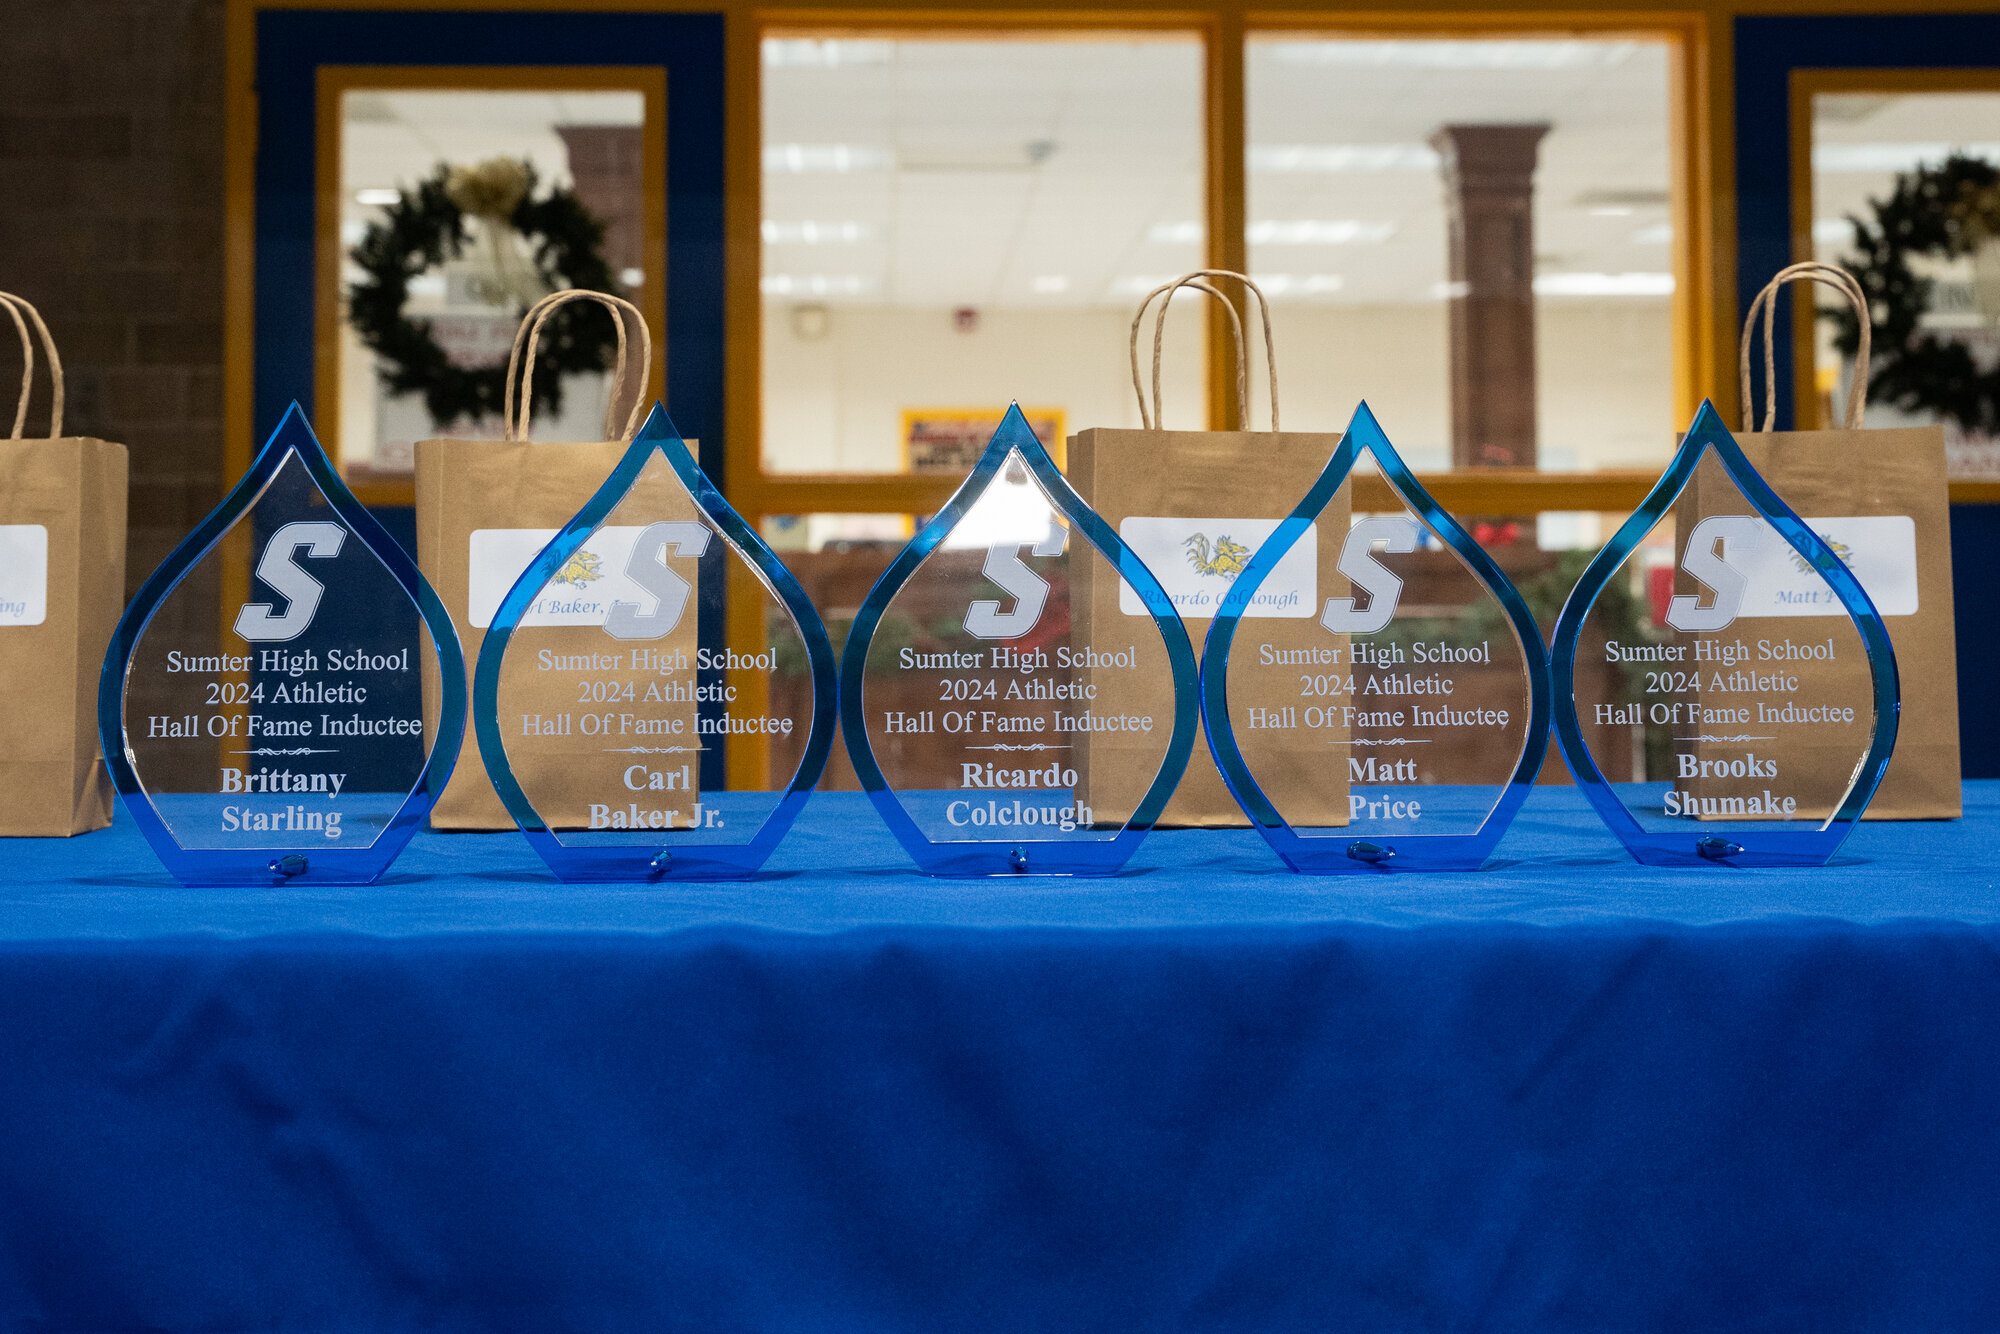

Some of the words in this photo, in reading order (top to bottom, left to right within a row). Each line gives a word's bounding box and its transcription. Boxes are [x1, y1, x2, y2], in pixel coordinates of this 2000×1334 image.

[233, 521, 347, 642] S
[602, 521, 713, 641] S
[1320, 517, 1420, 635] S
[1665, 515, 1764, 632] S
[548, 598, 604, 615] Baker,
[1774, 590, 1818, 604] Matt
[166, 650, 253, 673] Sumter
[259, 650, 319, 677] High
[327, 648, 408, 672] School
[538, 650, 622, 672] Sumter
[630, 648, 688, 676] High
[697, 648, 778, 671] School
[900, 648, 984, 670] Sumter
[990, 646, 1049, 674] High
[1057, 646, 1136, 669] School
[1259, 644, 1342, 666] Sumter
[1350, 642, 1406, 669] High
[1413, 640, 1490, 664] School
[1605, 640, 1687, 662] Sumter
[1693, 640, 1750, 667] High
[1757, 638, 1836, 661] School
[205, 682, 265, 705] 2024
[271, 681, 367, 705] Athletic
[578, 681, 636, 703] 2024
[643, 679, 737, 702] Athletic
[939, 679, 997, 700] 2024
[1003, 678, 1097, 700] Athletic
[1300, 674, 1357, 697] 2024
[1362, 672, 1454, 696] Athletic
[1645, 671, 1701, 693] 2024
[1708, 670, 1799, 692] Athletic
[147, 715, 199, 738] Hall
[207, 714, 242, 737] Of
[246, 715, 312, 737] Fame
[320, 714, 423, 736] Inductee
[522, 714, 572, 736] Hall
[580, 713, 611, 736] Of
[619, 713, 684, 735] Fame
[692, 712, 793, 734] Inductee
[884, 711, 935, 733] Hall
[942, 710, 977, 733] Of
[980, 711, 1046, 732] Fame
[1052, 710, 1153, 732] Inductee
[1248, 707, 1297, 729] Hall
[1304, 706, 1338, 728] Of
[1341, 706, 1405, 727] Fame
[1412, 705, 1509, 727] Inductee
[1593, 704, 1644, 725] Hall
[1650, 703, 1682, 725] Of
[1686, 703, 1750, 724] Fame
[1757, 702, 1855, 723] Inductee
[623, 765, 690, 791] Carl
[960, 762, 1078, 788] Ricardo
[1346, 757, 1418, 782] Matt
[1676, 753, 1778, 778] Brooks
[220, 767, 346, 798] Brittany
[946, 800, 1094, 831] Colclough
[1346, 794, 1421, 820] Price
[1664, 790, 1797, 816] Shumake
[221, 805, 342, 838] Starling
[588, 803, 678, 830] Baker
[686, 803, 724, 830] Jr.
